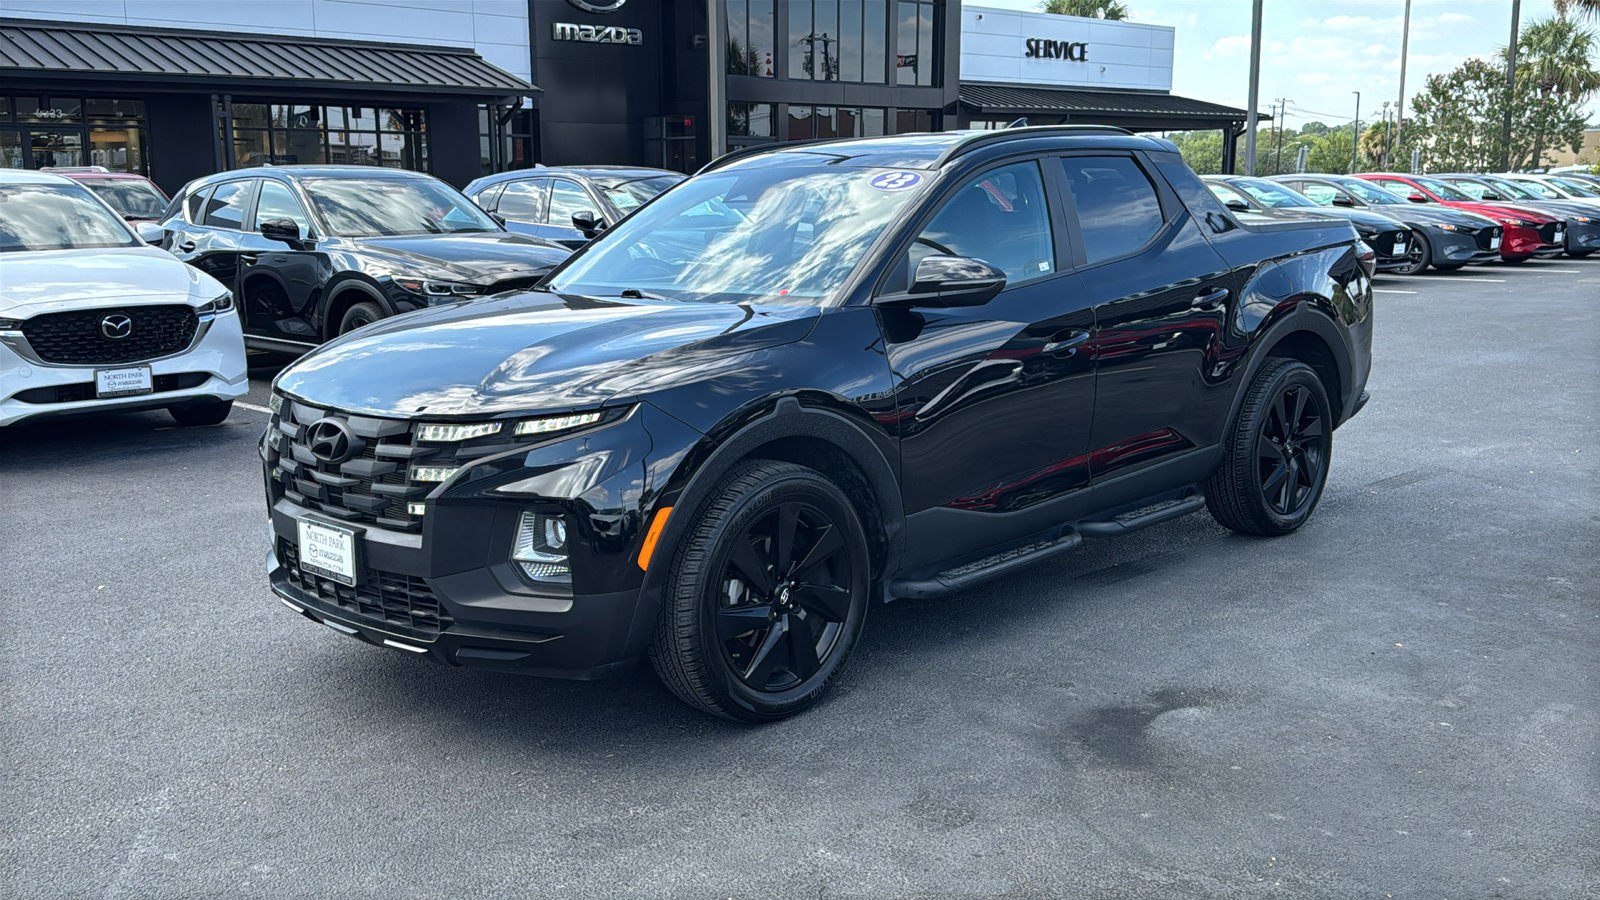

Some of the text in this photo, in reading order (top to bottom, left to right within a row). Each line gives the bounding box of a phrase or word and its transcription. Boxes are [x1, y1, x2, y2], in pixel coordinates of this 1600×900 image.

[552, 22, 643, 46] mazda
[1025, 37, 1089, 62] SERVICE
[874, 172, 915, 189] 23
[305, 530, 346, 551] NORTH PARK
